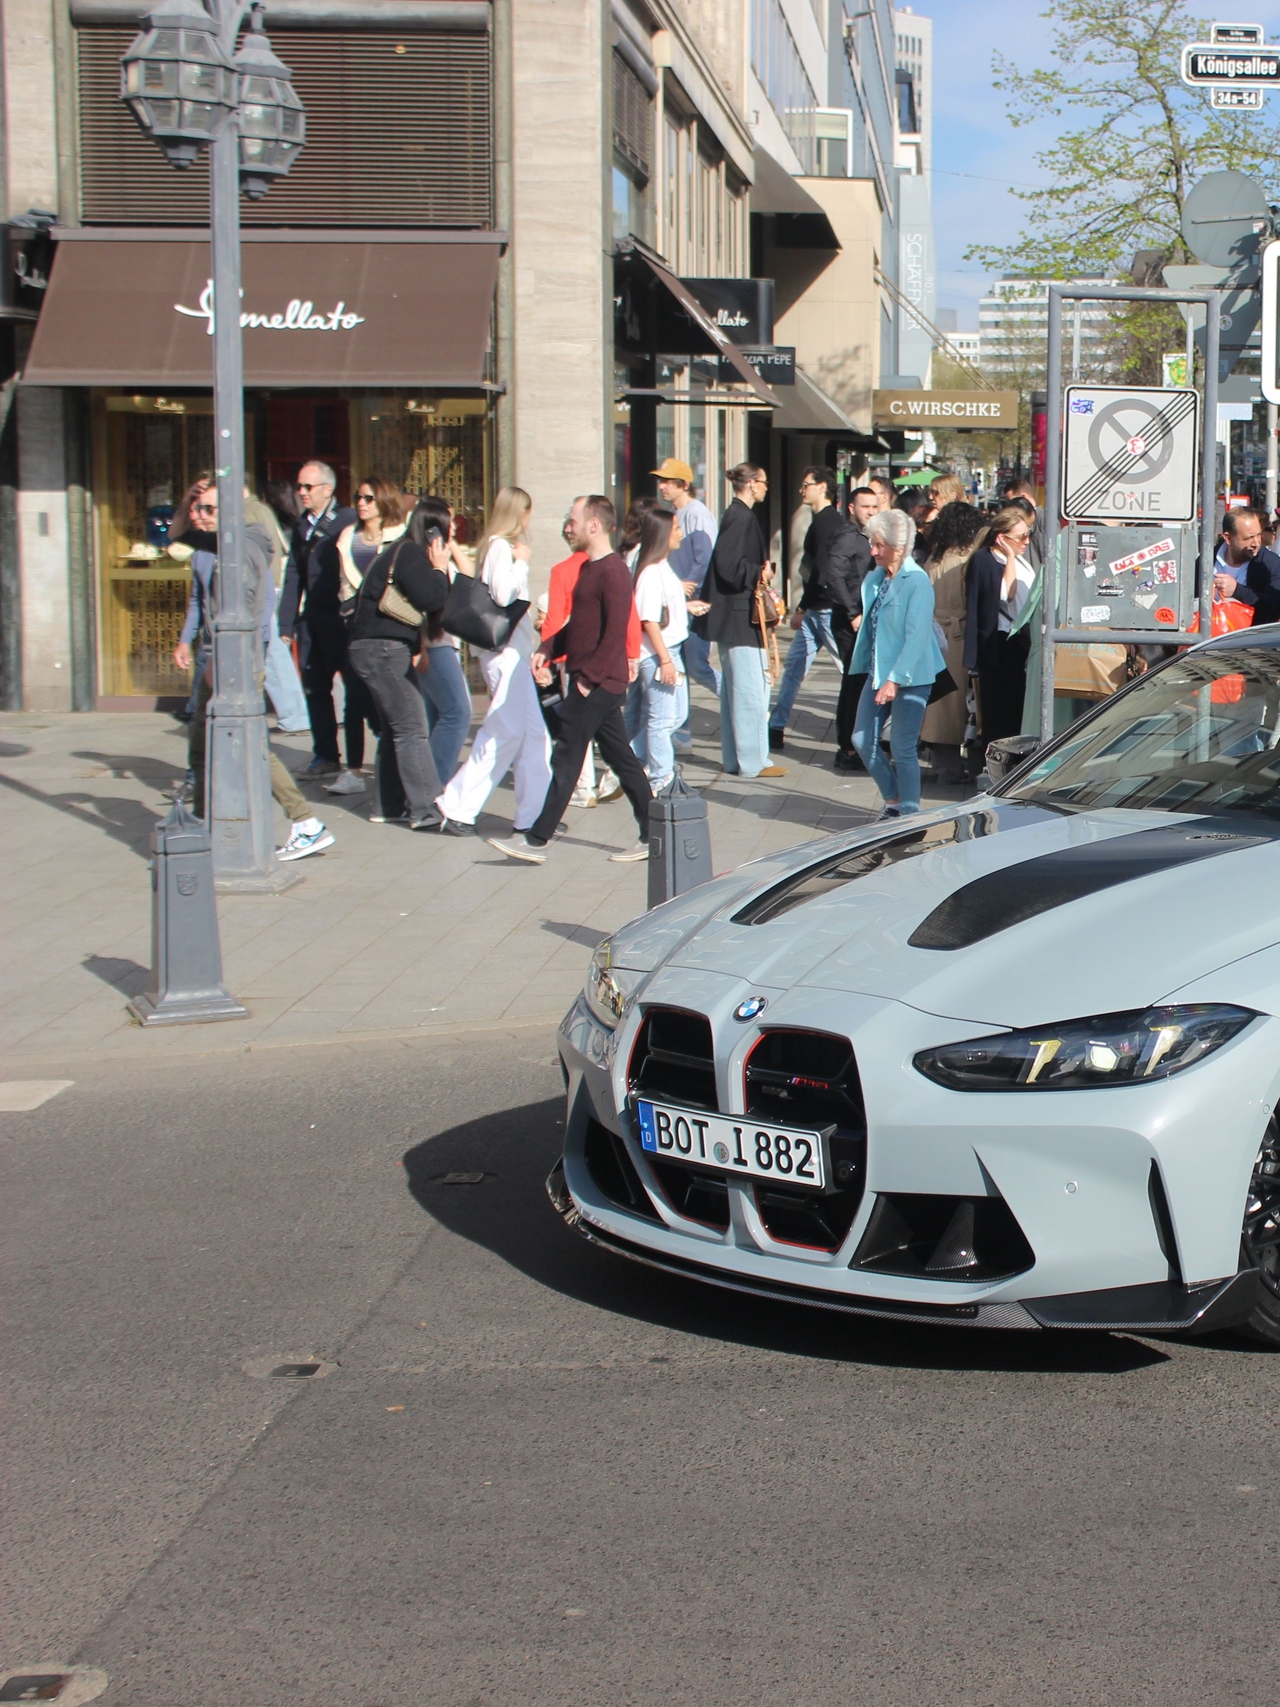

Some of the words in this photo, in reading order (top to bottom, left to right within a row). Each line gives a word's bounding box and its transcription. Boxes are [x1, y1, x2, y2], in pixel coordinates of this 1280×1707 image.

[1198, 55, 1277, 77] Königsallee
[1218, 92, 1257, 104] 34a-54
[907, 234, 922, 331] SCHÄFFNER
[174, 279, 365, 335] Pmellato
[768, 354, 791, 365] PEPE
[1097, 491, 1161, 511] ZONE
[645, 1131, 652, 1143] D
[655, 1110, 709, 1158] BOT
[755, 1131, 815, 1179] 882
